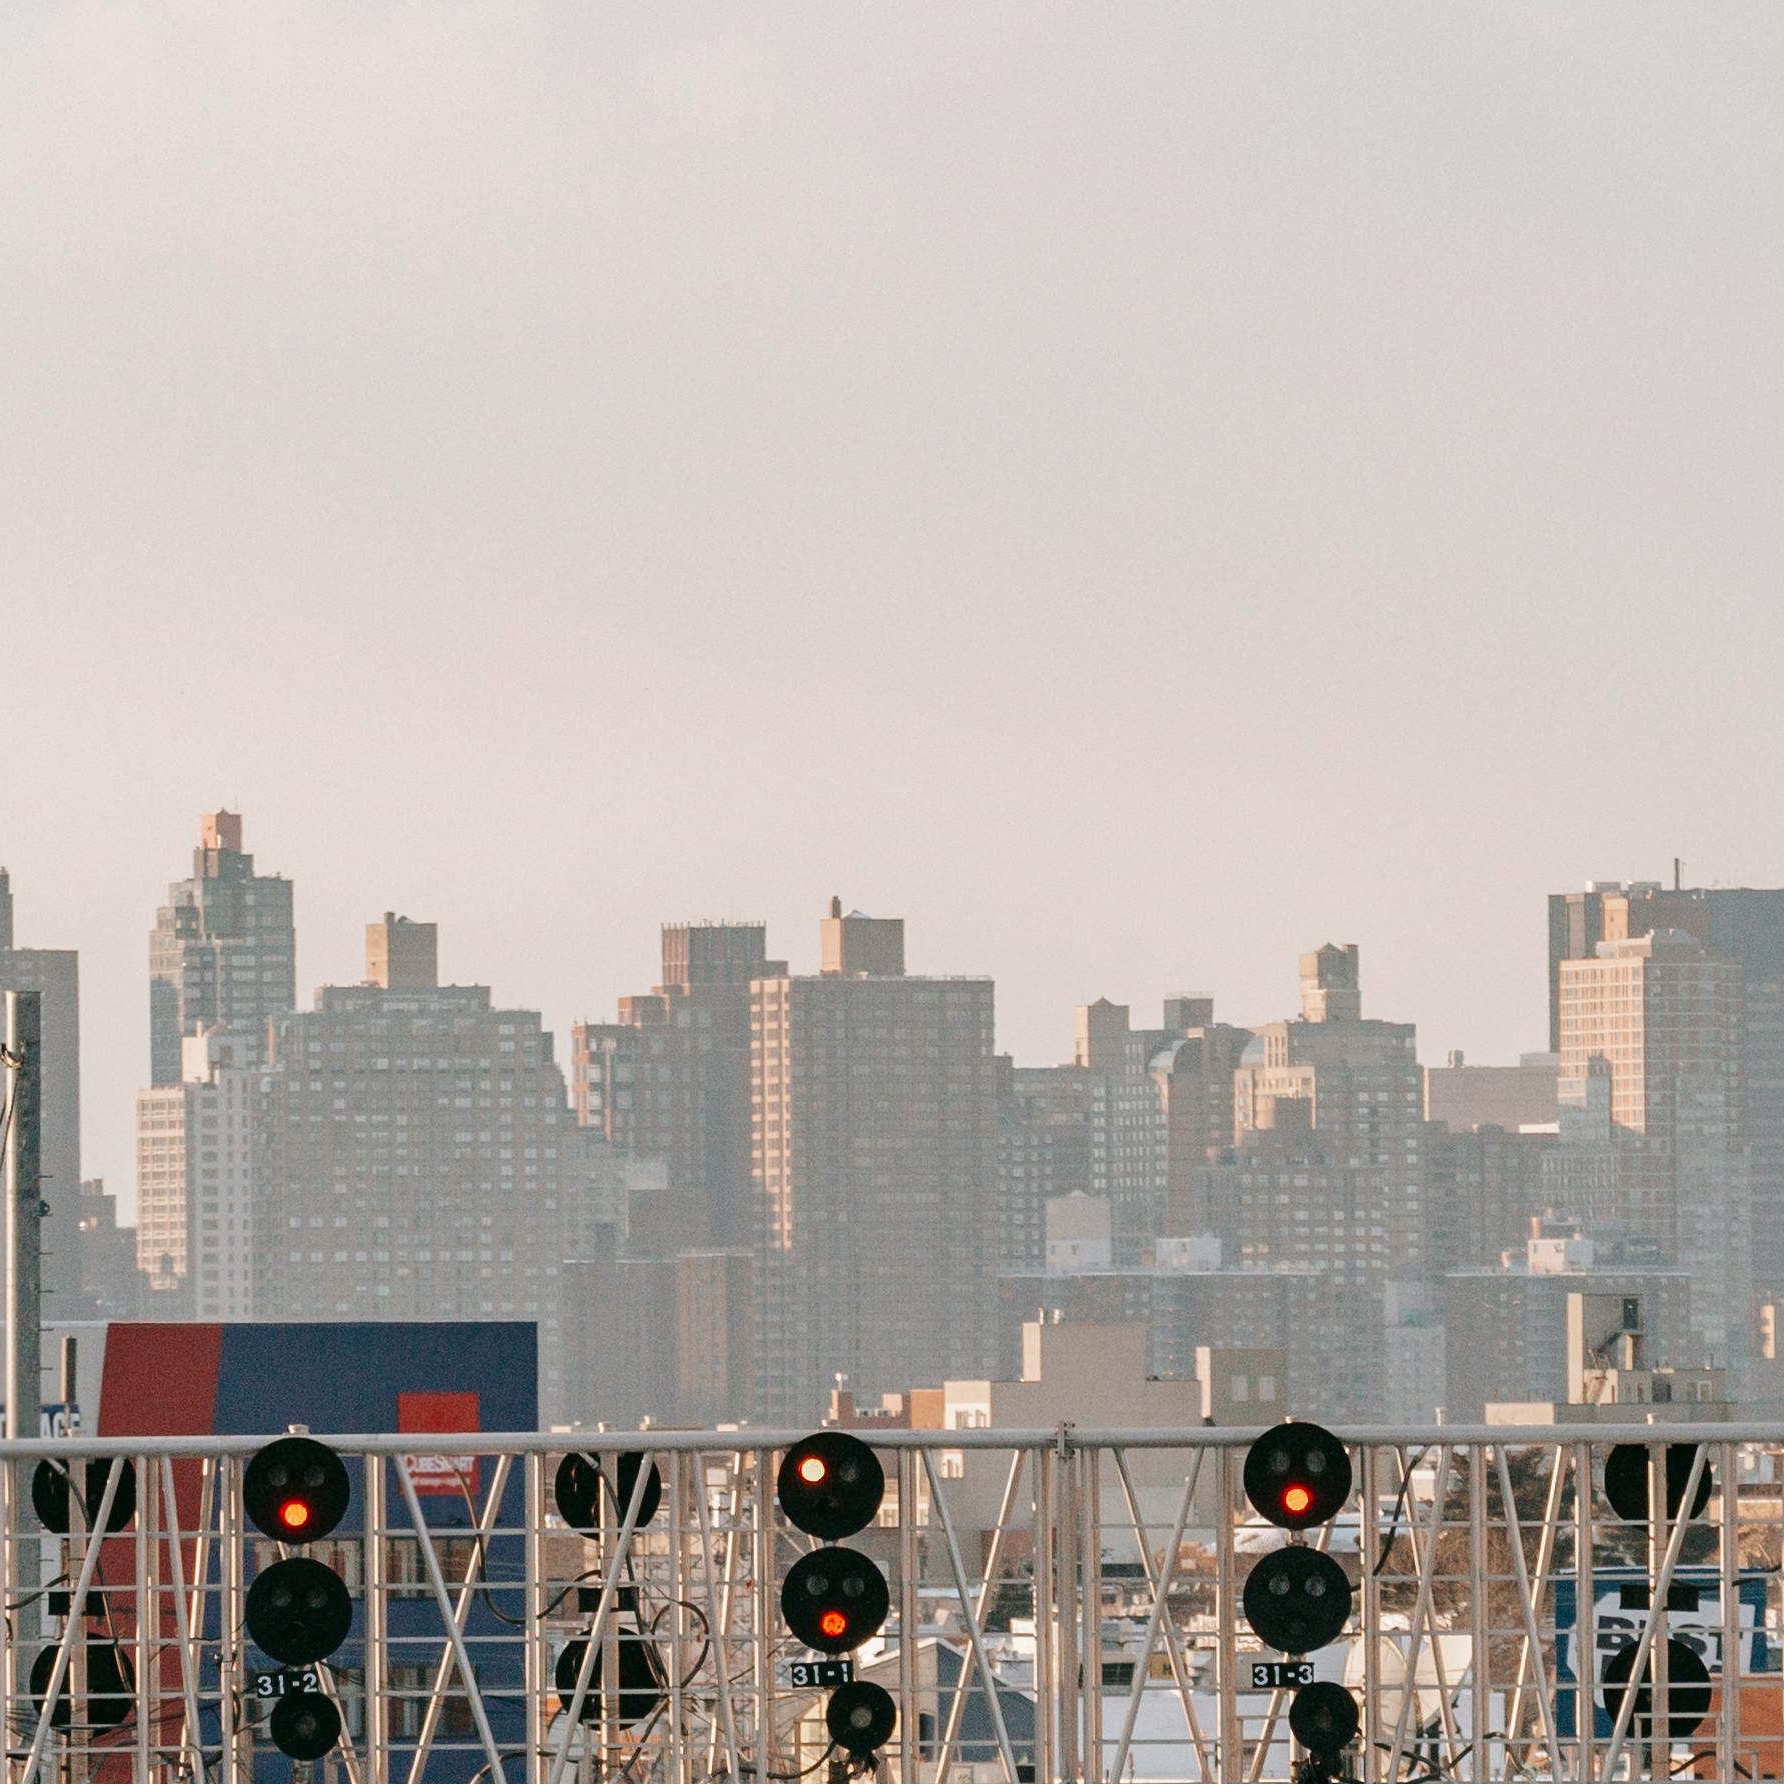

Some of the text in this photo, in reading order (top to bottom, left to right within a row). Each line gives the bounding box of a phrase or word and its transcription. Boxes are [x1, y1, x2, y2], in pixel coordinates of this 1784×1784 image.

[257, 1673, 317, 1695] 31-2
[793, 1663, 848, 1685] 31-1
[1254, 1665, 1313, 1685] 31-3
